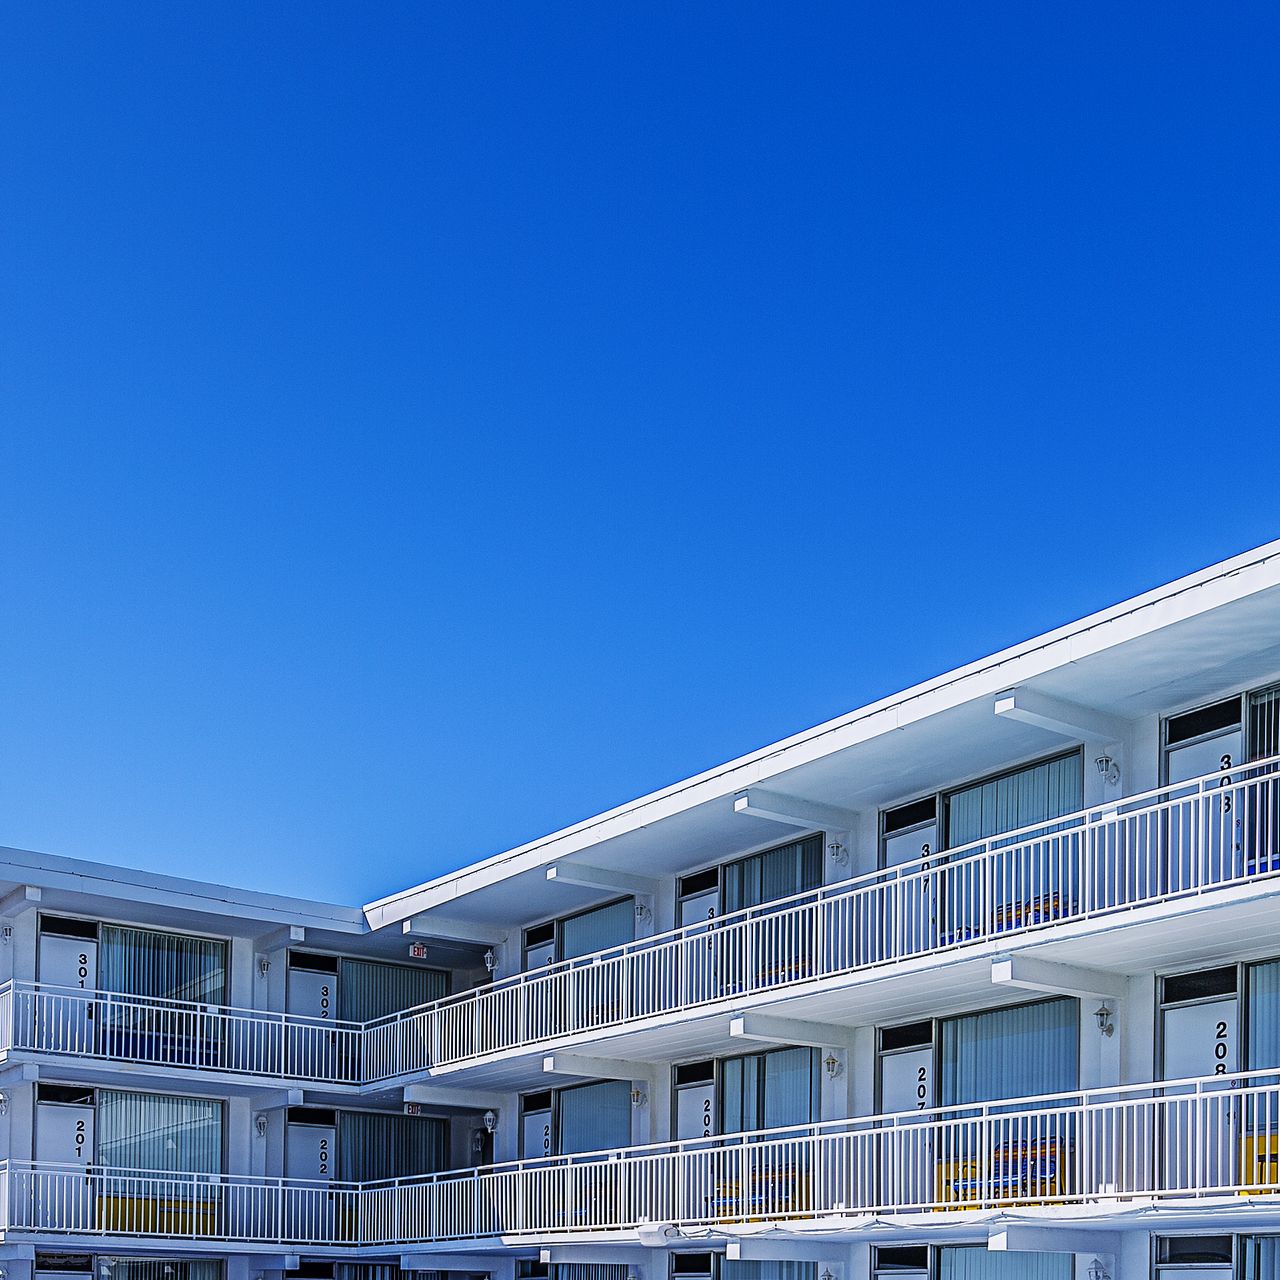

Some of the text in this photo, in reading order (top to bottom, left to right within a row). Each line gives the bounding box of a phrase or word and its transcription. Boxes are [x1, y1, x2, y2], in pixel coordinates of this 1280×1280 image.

[78, 953, 88, 989] 301
[321, 986, 329, 1018] 302
[1215, 1021, 1227, 1075] 208
[917, 1067, 926, 1111] 207
[75, 1120, 85, 1157] 201
[319, 1139, 328, 1174] 202
